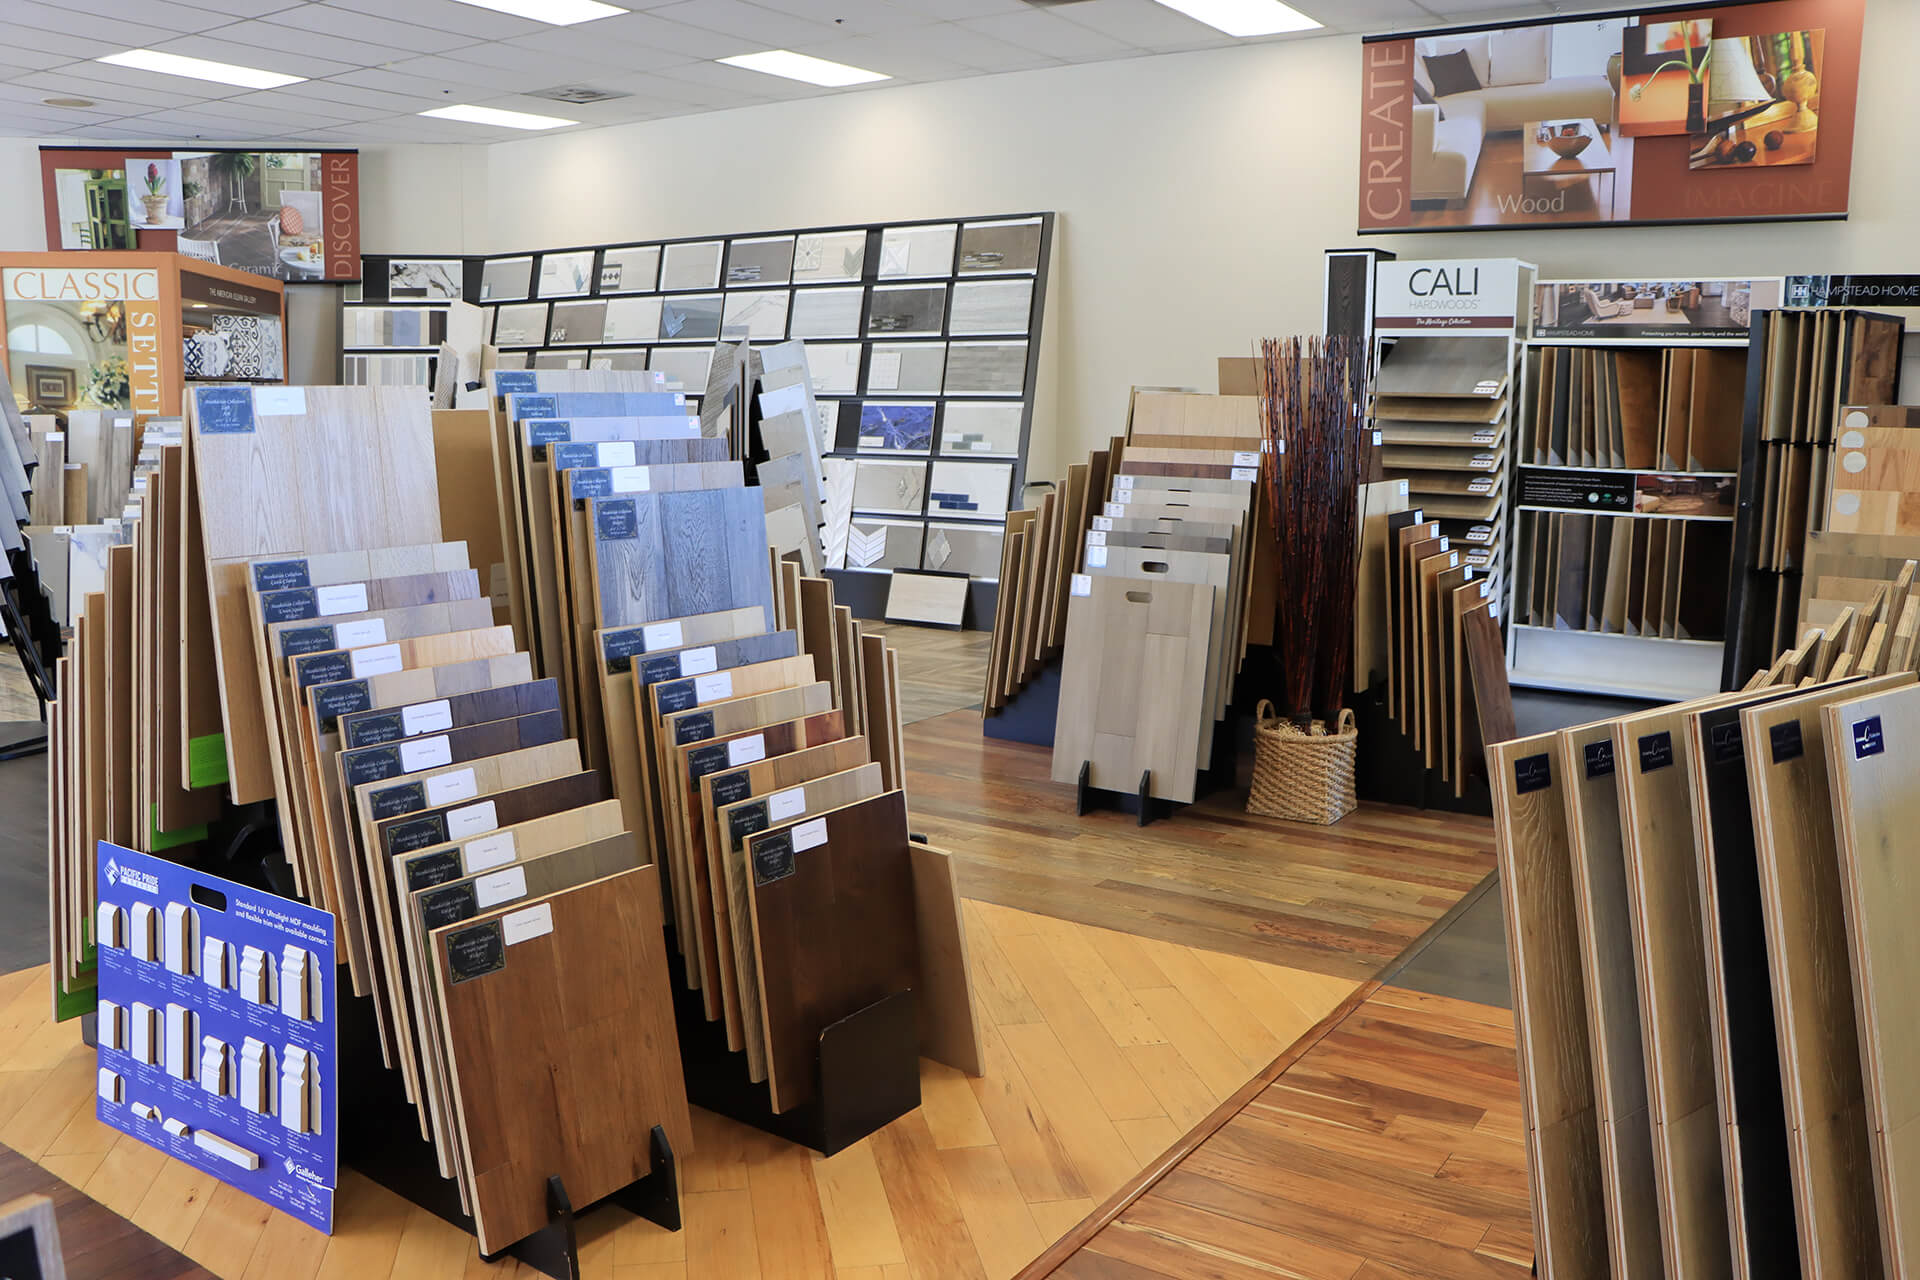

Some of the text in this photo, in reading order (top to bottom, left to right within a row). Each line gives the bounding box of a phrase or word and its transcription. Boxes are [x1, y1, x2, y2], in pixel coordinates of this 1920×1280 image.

[1366, 44, 1407, 221] CREATE
[1496, 190, 1565, 214] Wood
[1685, 180, 1833, 209] IMAGINE
[331, 158, 352, 277] DISCOVER
[13, 271, 156, 300] CLASSIC
[1408, 267, 1479, 296] CALI
[1811, 285, 1880, 297] HAMPSTEAD
[1881, 285, 1919, 296] HOME
[131, 312, 160, 427] SETTI
[120, 865, 141, 881] PACIFIC
[143, 872, 159, 886] PRIDE
[235, 898, 256, 911] Standard
[290, 917, 301, 926] MDF
[302, 922, 326, 936] moulding
[235, 910, 245, 918] and
[246, 912, 262, 924] flexible
[263, 919, 273, 927] trim
[274, 922, 285, 931] with
[285, 927, 307, 939] available
[295, 1164, 324, 1183] Galleher
